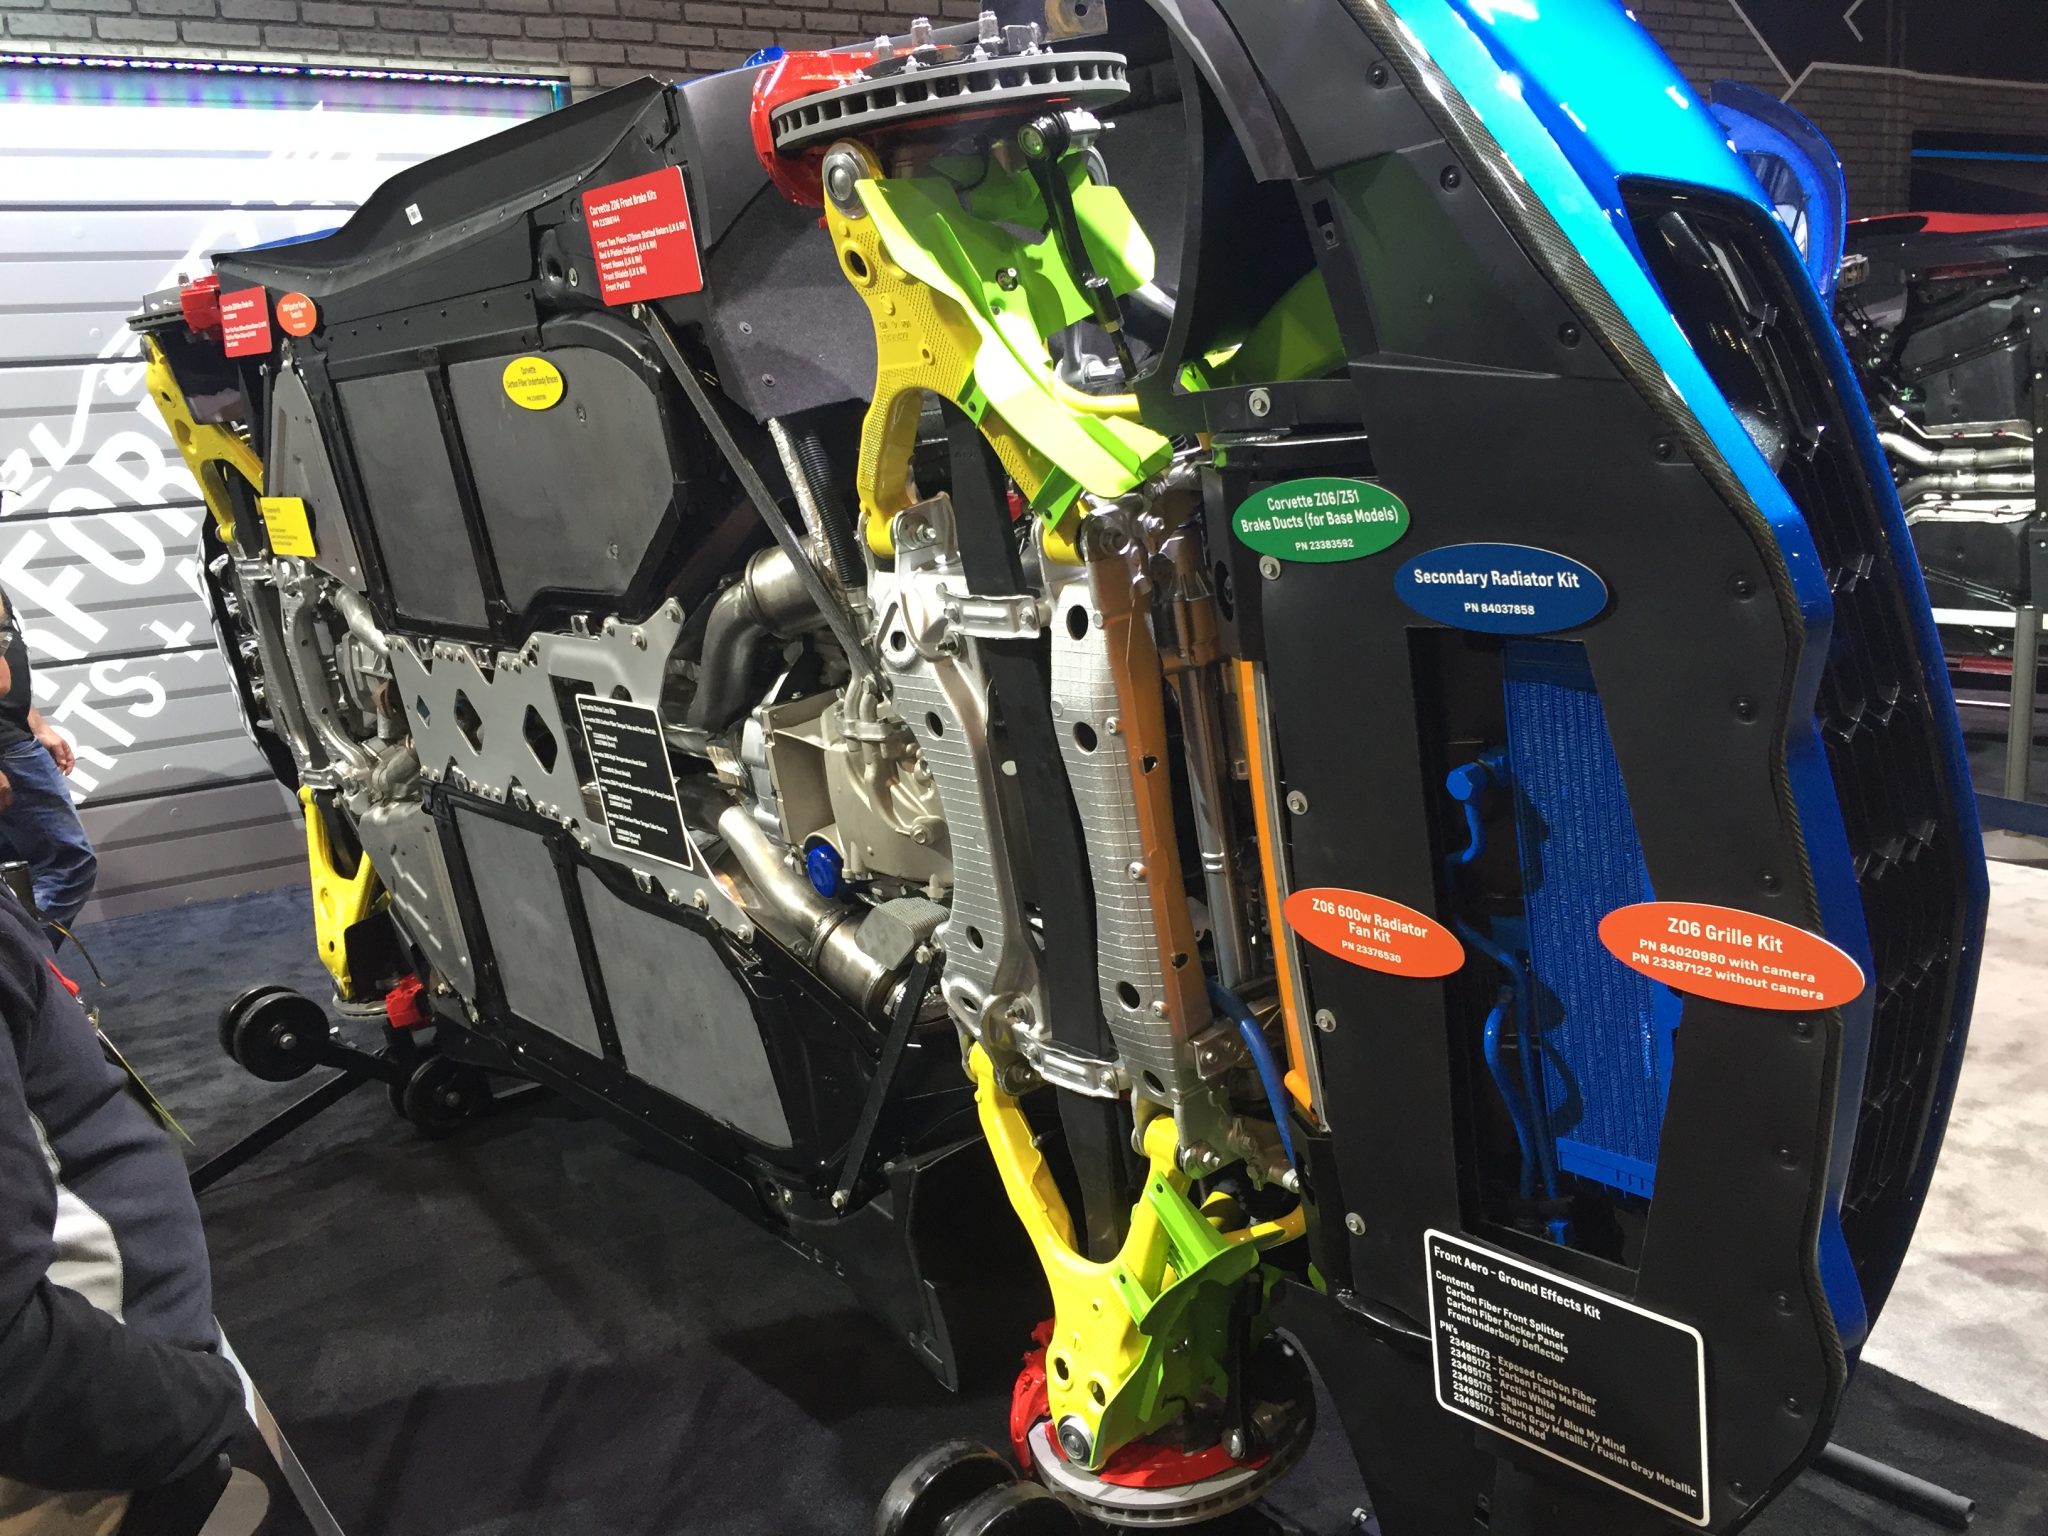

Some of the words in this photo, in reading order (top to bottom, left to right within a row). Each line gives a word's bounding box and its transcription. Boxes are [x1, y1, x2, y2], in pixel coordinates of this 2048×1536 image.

[1241, 518, 1271, 532] Brake
[1274, 516, 1303, 530] Ducts
[1305, 512, 1324, 530] (for
[1327, 512, 1353, 525] Base
[1354, 505, 1398, 524] Models)
[1267, 495, 1313, 511] Corvette
[1314, 489, 1359, 506] Z06/Z51
[1295, 542, 1308, 551] PN
[1309, 539, 1354, 550] 23383592
[1414, 569, 1488, 588] Secondary
[1491, 570, 1553, 587] Radiator
[1557, 572, 1580, 588] Kit
[1464, 603, 1479, 613] PN
[1481, 603, 1535, 615] 84037858
[1312, 898, 1335, 915] Z06
[1338, 905, 1371, 924] 600w
[1374, 913, 1428, 938] Radiator
[1349, 921, 1370, 938] Fan
[1374, 928, 1392, 944] Kit
[1667, 916, 1701, 937] Z06
[1705, 924, 1753, 947] Grille
[1758, 934, 1783, 953] Kit
[1342, 940, 1354, 950] PN
[1356, 944, 1401, 963] 23376530
[1639, 939, 1657, 951] PN
[1660, 942, 1726, 964] 84020980
[1728, 958, 1758, 972] with
[1762, 965, 1815, 983] camera
[1632, 953, 1650, 964] PN
[1652, 956, 1712, 977] 23387122
[1716, 971, 1767, 989] without
[1771, 982, 1824, 1001] camera
[1434, 1246, 1462, 1266] Front
[1464, 1257, 1489, 1275] Aero
[1498, 1270, 1538, 1296] Ground
[1541, 1286, 1581, 1312] Effects
[1585, 1302, 1601, 1320] Kit
[1436, 1270, 1475, 1292] Contents
[1440, 1320, 1458, 1334] PN's
[1446, 1285, 1477, 1304] Carbon
[1479, 1298, 1502, 1313] Fiber
[1504, 1308, 1527, 1325] Front
[1529, 1319, 1565, 1340] Splitter
[1447, 1297, 1478, 1316] Carbon
[1480, 1310, 1502, 1326] Fiber
[1504, 1320, 1535, 1340] Rocker
[1538, 1333, 1568, 1354] Panels
[1448, 1308, 1470, 1324] Front
[1473, 1318, 1520, 1346] Underbody
[1523, 1339, 1565, 1363] Deflector
[1450, 1336, 1490, 1359] 23495173
[1498, 1356, 1535, 1379] Exposed
[1537, 1372, 1570, 1394] Carbon
[1572, 1388, 1597, 1405] Fiber
[1451, 1347, 1491, 1371] 23495172
[1499, 1367, 1530, 1388] Carbon
[1533, 1382, 1557, 1400] Flash
[1559, 1394, 1596, 1417] Metallic
[1452, 1358, 1492, 1382] 23495175
[1500, 1380, 1526, 1398] Arctic
[1528, 1391, 1555, 1410] White
[1452, 1370, 1492, 1394] 23495176
[1501, 1391, 1533, 1412] Laguna
[1535, 1406, 1555, 1422] Blue
[1564, 1419, 1584, 1435] Blue
[1586, 1428, 1600, 1443] My
[1602, 1435, 1626, 1454] Mind
[1454, 1392, 1494, 1416] 23495179
[1502, 1413, 1527, 1431] Torch
[1529, 1427, 1545, 1440] Red
[1453, 1381, 1493, 1405] 23495177
[1501, 1402, 1527, 1420] Shark
[1529, 1416, 1550, 1432] Gray
[1552, 1425, 1588, 1448] Metallic
[1598, 1444, 1629, 1468] Fusion
[1631, 1460, 1654, 1479] Gray
[1656, 1471, 1697, 1498] Metallic
